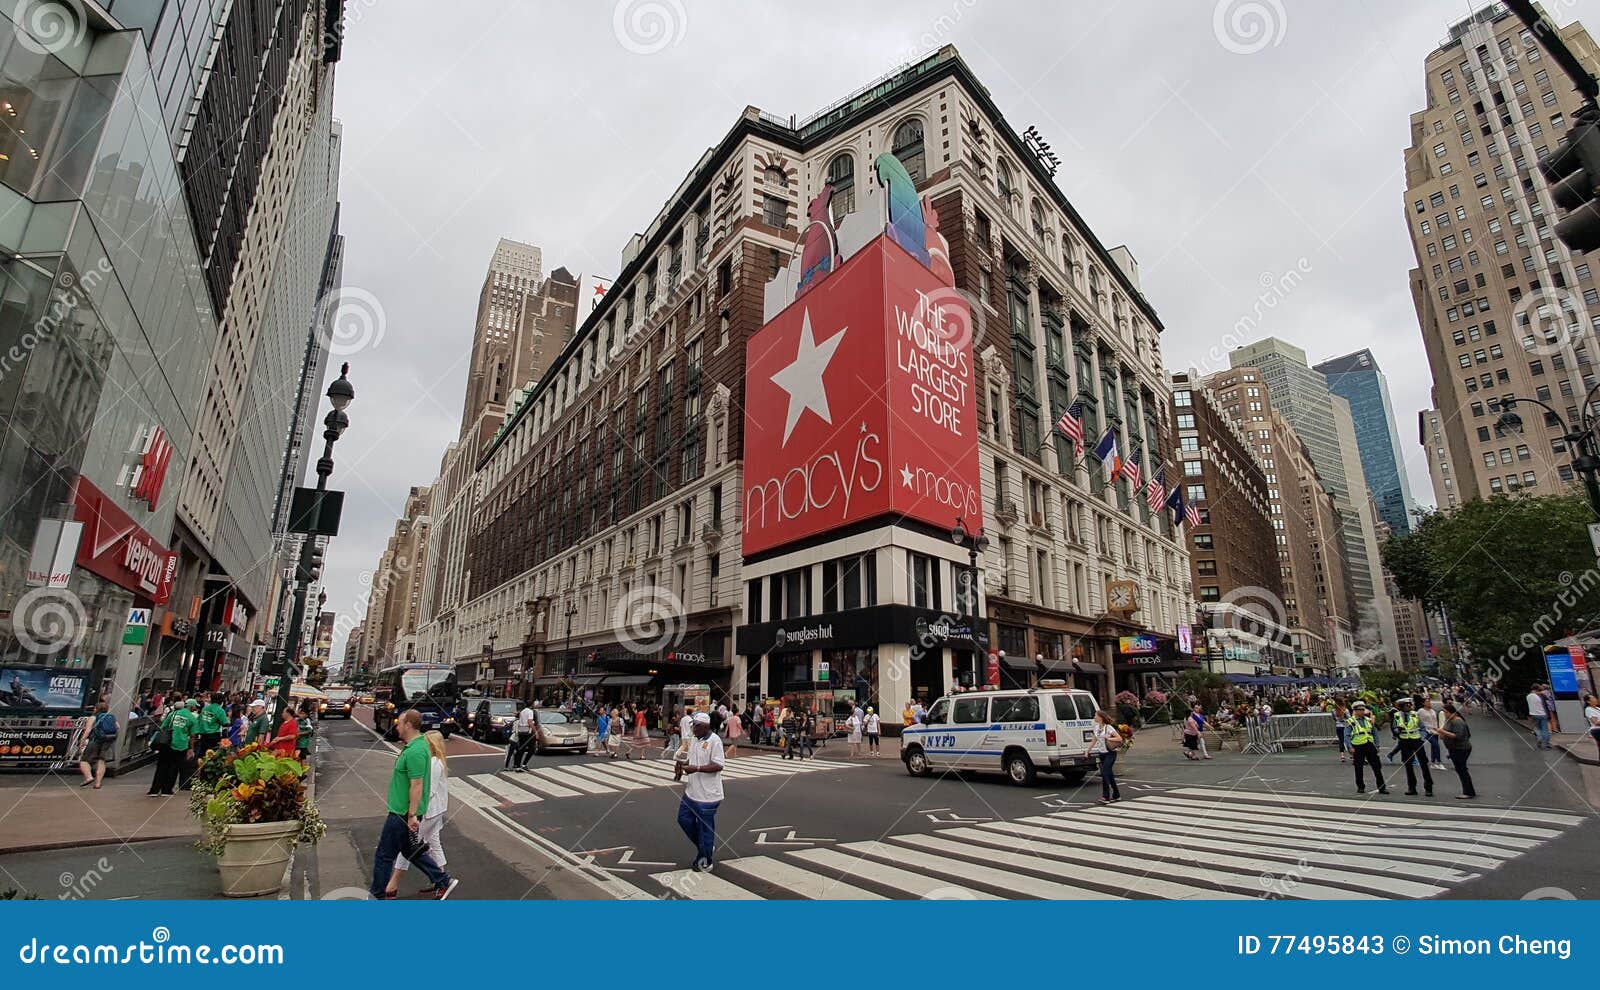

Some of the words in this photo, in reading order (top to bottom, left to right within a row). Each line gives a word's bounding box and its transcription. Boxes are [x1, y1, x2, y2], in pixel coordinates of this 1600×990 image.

[915, 289, 948, 334] THE
[895, 305, 968, 377] WORLD'S
[897, 341, 968, 406] LARGEST
[912, 383, 962, 436] STORE
[124, 535, 164, 594] verizon
[164, 556, 176, 583] verizon
[207, 630, 224, 642] 112
[786, 625, 818, 643] sunglass
[819, 624, 832, 639] hut
[928, 622, 961, 641] sungl
[50, 677, 83, 688] KEVIN
[926, 734, 956, 748] NYPD
